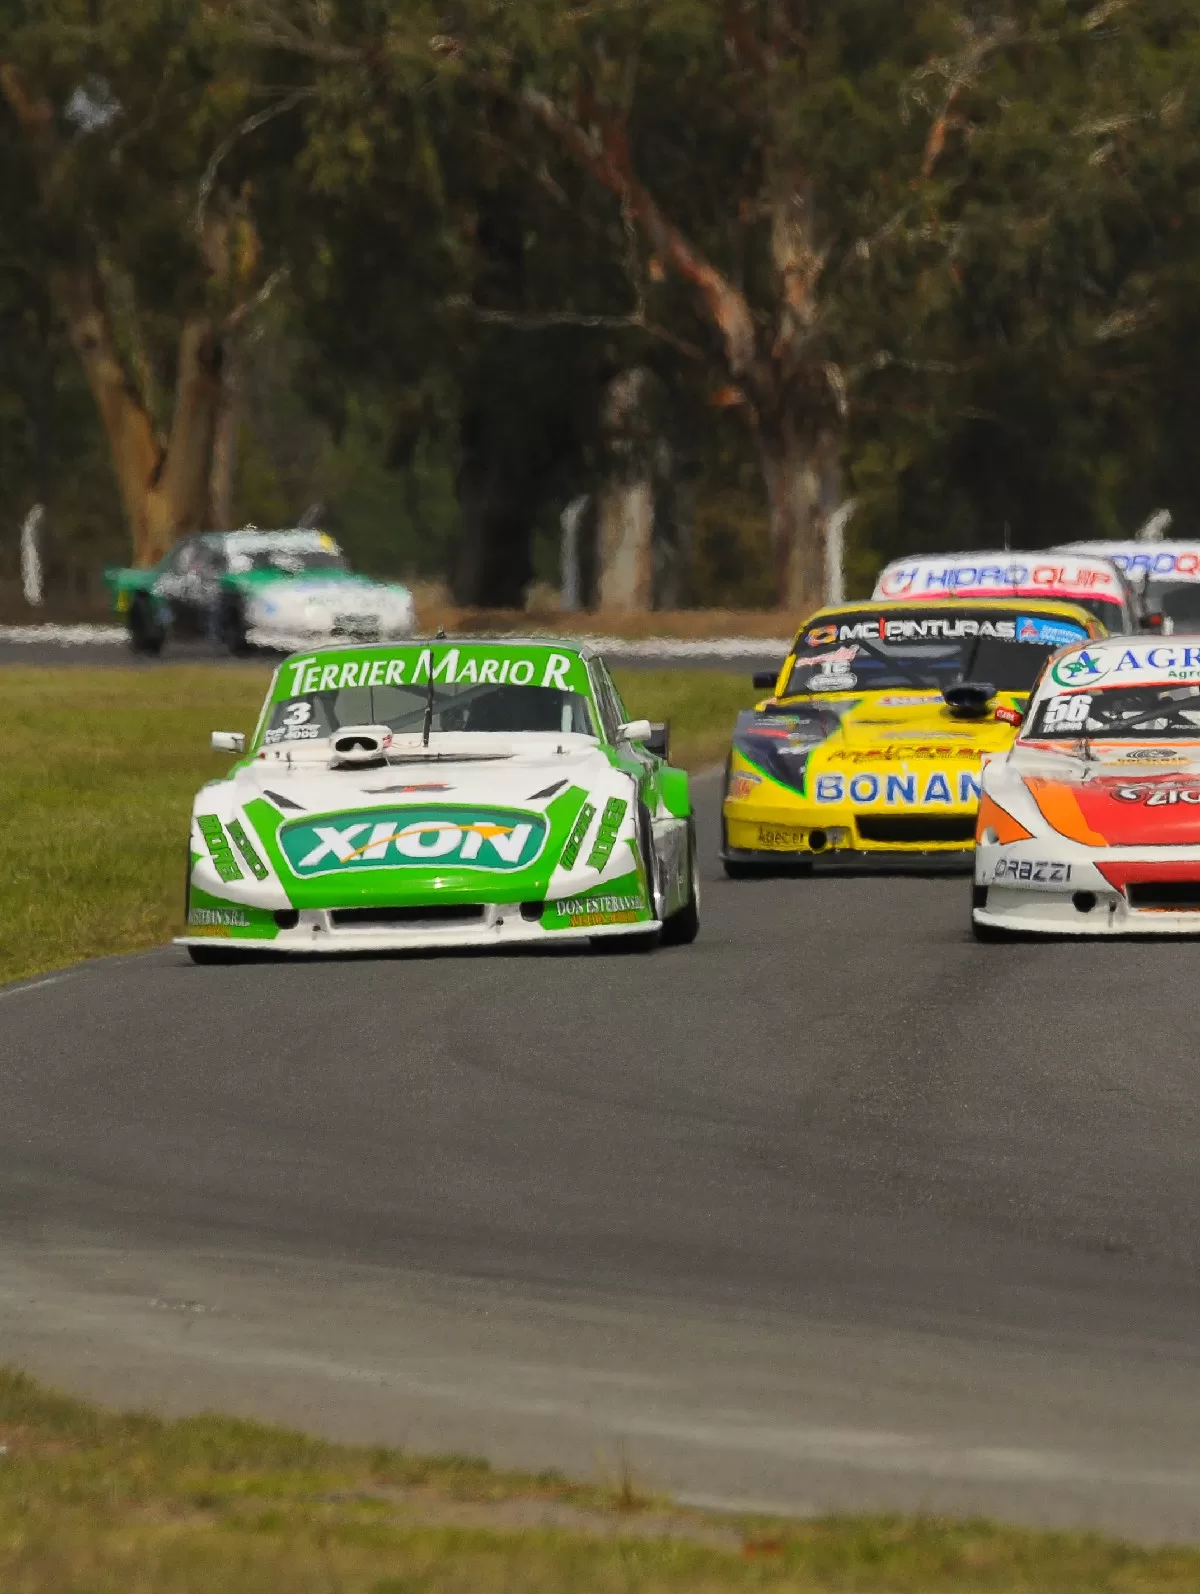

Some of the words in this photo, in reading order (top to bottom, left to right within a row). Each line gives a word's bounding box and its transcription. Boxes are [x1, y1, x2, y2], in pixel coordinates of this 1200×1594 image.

[886, 619, 1015, 640] PINTURAS
[289, 657, 405, 697] TERRIER
[411, 648, 534, 685] MARIO
[541, 653, 575, 692] R.
[283, 702, 312, 725] 3
[1043, 695, 1093, 723] 56
[815, 772, 983, 804] BONAN
[298, 820, 533, 867] XION
